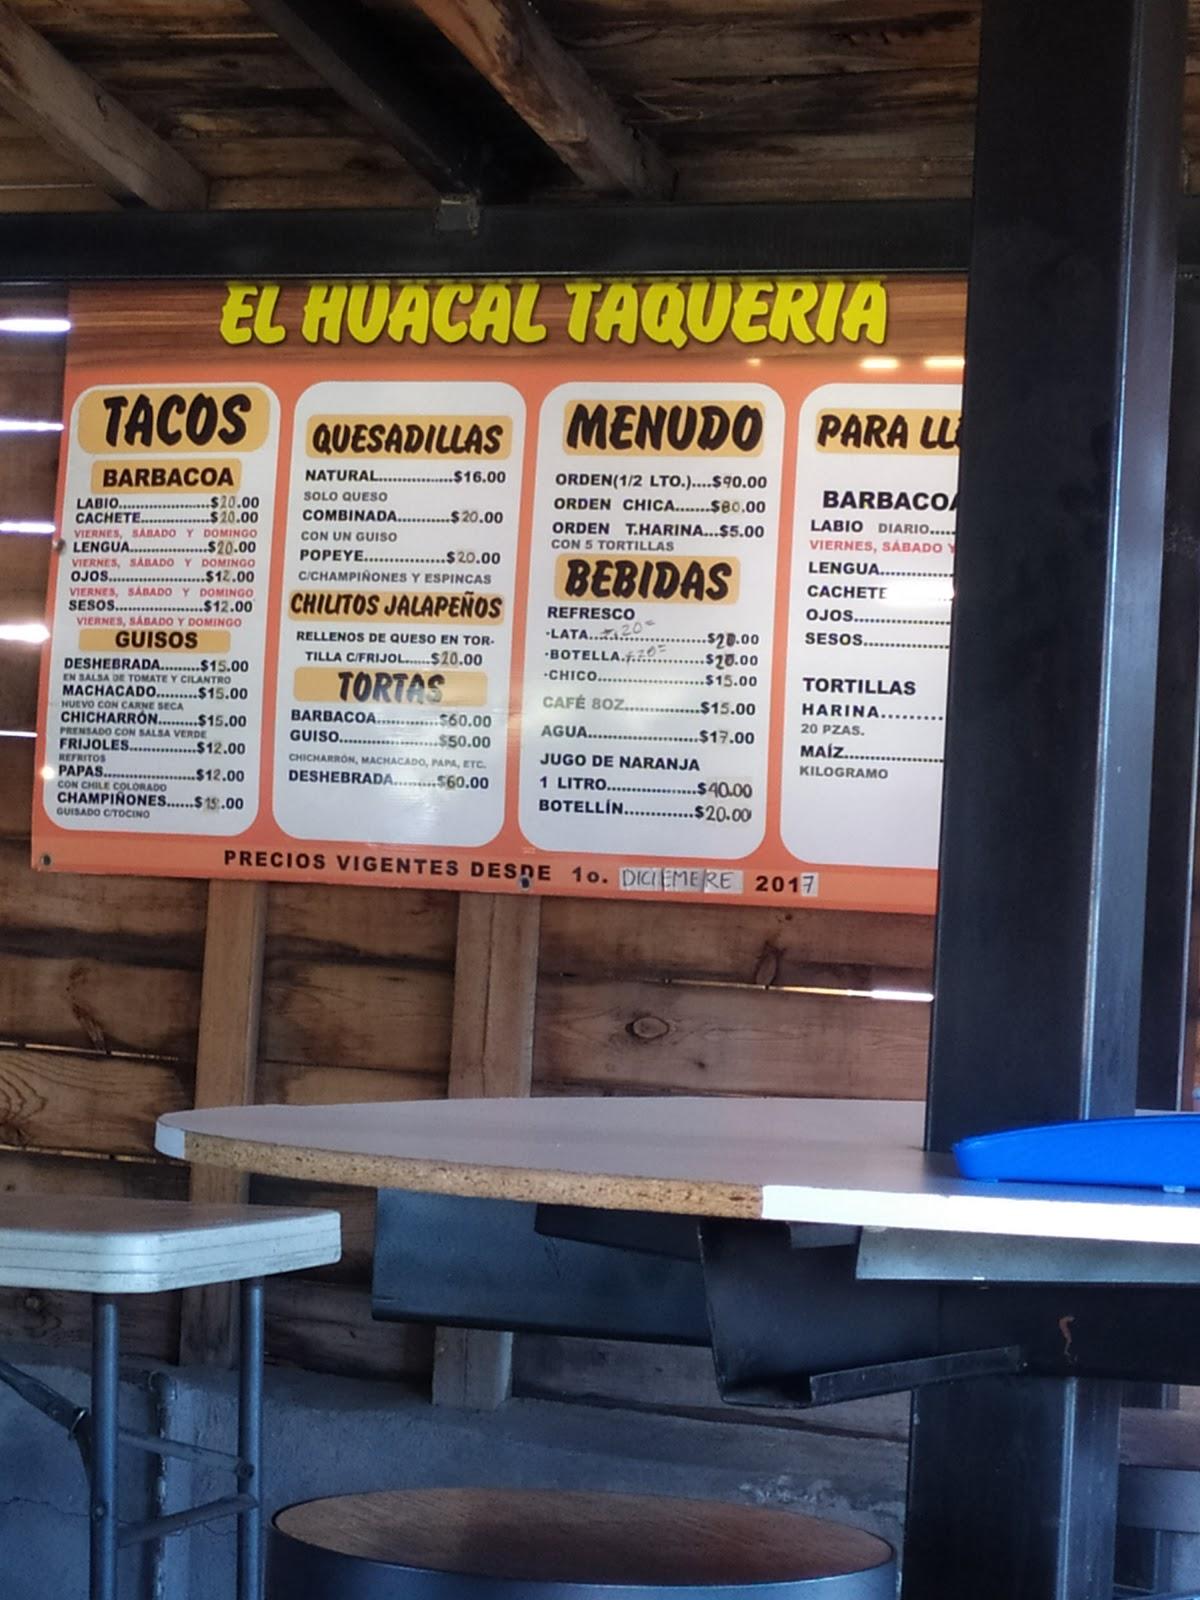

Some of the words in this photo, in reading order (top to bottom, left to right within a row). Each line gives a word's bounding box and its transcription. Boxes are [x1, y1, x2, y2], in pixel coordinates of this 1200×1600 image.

[220, 280, 286, 344] EL
[302, 279, 547, 344] HUACAL
[565, 276, 887, 349] TAQUERIA
[103, 393, 251, 447] TACOS
[567, 404, 763, 452] MENUDO
[817, 414, 908, 449] PARA
[312, 423, 503, 455] QUESADILLAS
[103, 468, 234, 487] BARBACOA
[305, 470, 378, 482] NATURAL
[454, 471, 506, 484] $16.00
[712, 476, 767, 488] $90.00
[77, 498, 119, 509] LABIO
[211, 496, 259, 509] $20.00
[304, 492, 338, 501] SOLO
[342, 492, 388, 502] QUESO
[554, 498, 611, 510] ORDEN
[623, 499, 675, 511] CHICA
[76, 513, 141, 523] CACHETE
[210, 511, 258, 524] $20.00
[303, 510, 397, 522] COMBINADA
[450, 510, 503, 523] $20.00
[74, 530, 122, 539] VIERNES,
[132, 528, 176, 538] SÁBADO
[187, 529, 193, 537] Y
[204, 530, 257, 538] DOMINGO
[552, 522, 610, 534] ORDEN
[625, 523, 703, 536] T.HARINA
[719, 525, 764, 538] $5.00
[811, 520, 863, 533] LABIO
[878, 523, 929, 534] DIARIO
[301, 532, 329, 541] CON
[333, 532, 351, 541] UN
[356, 532, 398, 542] GUISO
[73, 542, 130, 552] LENGUA
[208, 541, 256, 554] $20.00
[552, 539, 580, 549] CON
[585, 540, 593, 549] 5
[597, 540, 674, 551] TORTILLAS
[810, 540, 877, 553] VIERNES,
[882, 540, 943, 553] SÁBADO
[72, 559, 120, 568] VIERNES,
[130, 557, 174, 567] SÁBADO
[184, 559, 191, 567] Y
[202, 559, 255, 567] DOMINGO
[300, 550, 363, 561] POPEYE
[446, 551, 500, 564] $20.00
[809, 562, 880, 575] LENGUA
[71, 571, 108, 582] OJOS
[206, 571, 254, 583] $12.00
[298, 570, 407, 582] C/CHAMPIÑONES
[412, 573, 420, 583] Y
[425, 574, 491, 584] ESPINCAS
[565, 559, 732, 601] BEBIDAS
[69, 588, 118, 598] VIERNES,
[128, 587, 172, 596] SÁBADO
[183, 588, 190, 596] Y
[200, 588, 253, 597] DOMINGO
[808, 585, 888, 599] CACHETE
[69, 601, 115, 611] SESOS
[204, 601, 252, 613] $12.00
[290, 592, 380, 616] CHILITOS
[384, 592, 502, 618] JALAPEÑOS
[547, 607, 635, 620] REFRESCO
[806, 609, 854, 622] OJOS
[77, 617, 125, 627] VIERNES,
[129, 615, 173, 626] SÁBADO
[178, 617, 185, 626] Y
[188, 618, 242, 627] DOMINGO
[115, 632, 198, 649] GUISOS
[296, 631, 364, 643] RELLENOS
[369, 633, 386, 643] DE
[390, 634, 436, 645] QUESO
[441, 635, 458, 645] EN
[464, 636, 495, 646] TOR-
[805, 633, 863, 646] SESOS
[64, 658, 160, 671] DESHEBRADA
[200, 660, 249, 673] $15.00
[306, 652, 342, 662] TILLA
[346, 652, 403, 664] C/FRIJOL
[431, 652, 482, 665] $20.00
[113, 675, 125, 683] DE
[128, 675, 167, 683] TOMATE
[181, 675, 231, 684] CILANTRO
[705, 675, 757, 687] $15.00
[803, 677, 916, 695] TORTILLAS
[63, 685, 156, 697] MACHACADO
[198, 687, 248, 700] $15.00
[338, 671, 445, 704] TORTAS
[99, 701, 119, 709] CON
[121, 701, 155, 710] CARNE
[158, 702, 184, 710] SECA
[543, 695, 586, 709] CAFÉ
[700, 702, 756, 716] $15.00
[802, 703, 879, 718] HARINA
[61, 711, 158, 725] CHICHARRÓN
[198, 714, 246, 727] $15.00
[291, 710, 376, 723] BARBACOA
[439, 714, 492, 728] $60.00
[60, 728, 112, 736] PRENSADO
[114, 728, 136, 736] CON
[139, 729, 171, 738] SALSA
[174, 730, 207, 738] VERDE
[541, 725, 587, 738] AGUA
[700, 730, 755, 744] $17.00
[801, 724, 817, 734] 20
[822, 725, 865, 736] PZAS.
[290, 730, 339, 743] GUISO
[438, 735, 491, 748] $50.00
[59, 738, 129, 751] FRIJOLES
[197, 742, 245, 755] $12.00
[800, 744, 845, 758] MAÍZ
[59, 754, 106, 762] REFRITOS
[289, 753, 359, 765] CHICHARRÓN,
[361, 756, 429, 768] MACHACADO,
[432, 760, 460, 769] PAPA,
[464, 761, 487, 769] ETC.
[540, 754, 586, 766] JUGO
[592, 756, 613, 767] DE
[619, 757, 700, 771] NARANJA
[58, 765, 103, 777] PAPAS
[196, 769, 244, 782] $12.00
[800, 766, 888, 779] KILOGRAMO
[58, 781, 79, 789] CON
[81, 781, 110, 790] CHILE
[113, 782, 167, 792] COLORADO
[288, 771, 393, 784] DESHEBRADA
[437, 775, 489, 789] $60.00
[540, 776, 547, 788] 1
[557, 777, 607, 790] LITRO
[698, 782, 752, 798] $40.00
[57, 791, 166, 807] CHAMPIÑONES
[57, 808, 100, 816] GUISADO
[103, 809, 150, 818] C/TOCINO
[539, 799, 624, 814] BOTELLÍN
[695, 805, 752, 822] $20.00
[224, 850, 326, 870] PRECIOS
[338, 856, 458, 876] VIGENTES
[471, 861, 551, 881] DESDE
[755, 875, 815, 894] 2017
